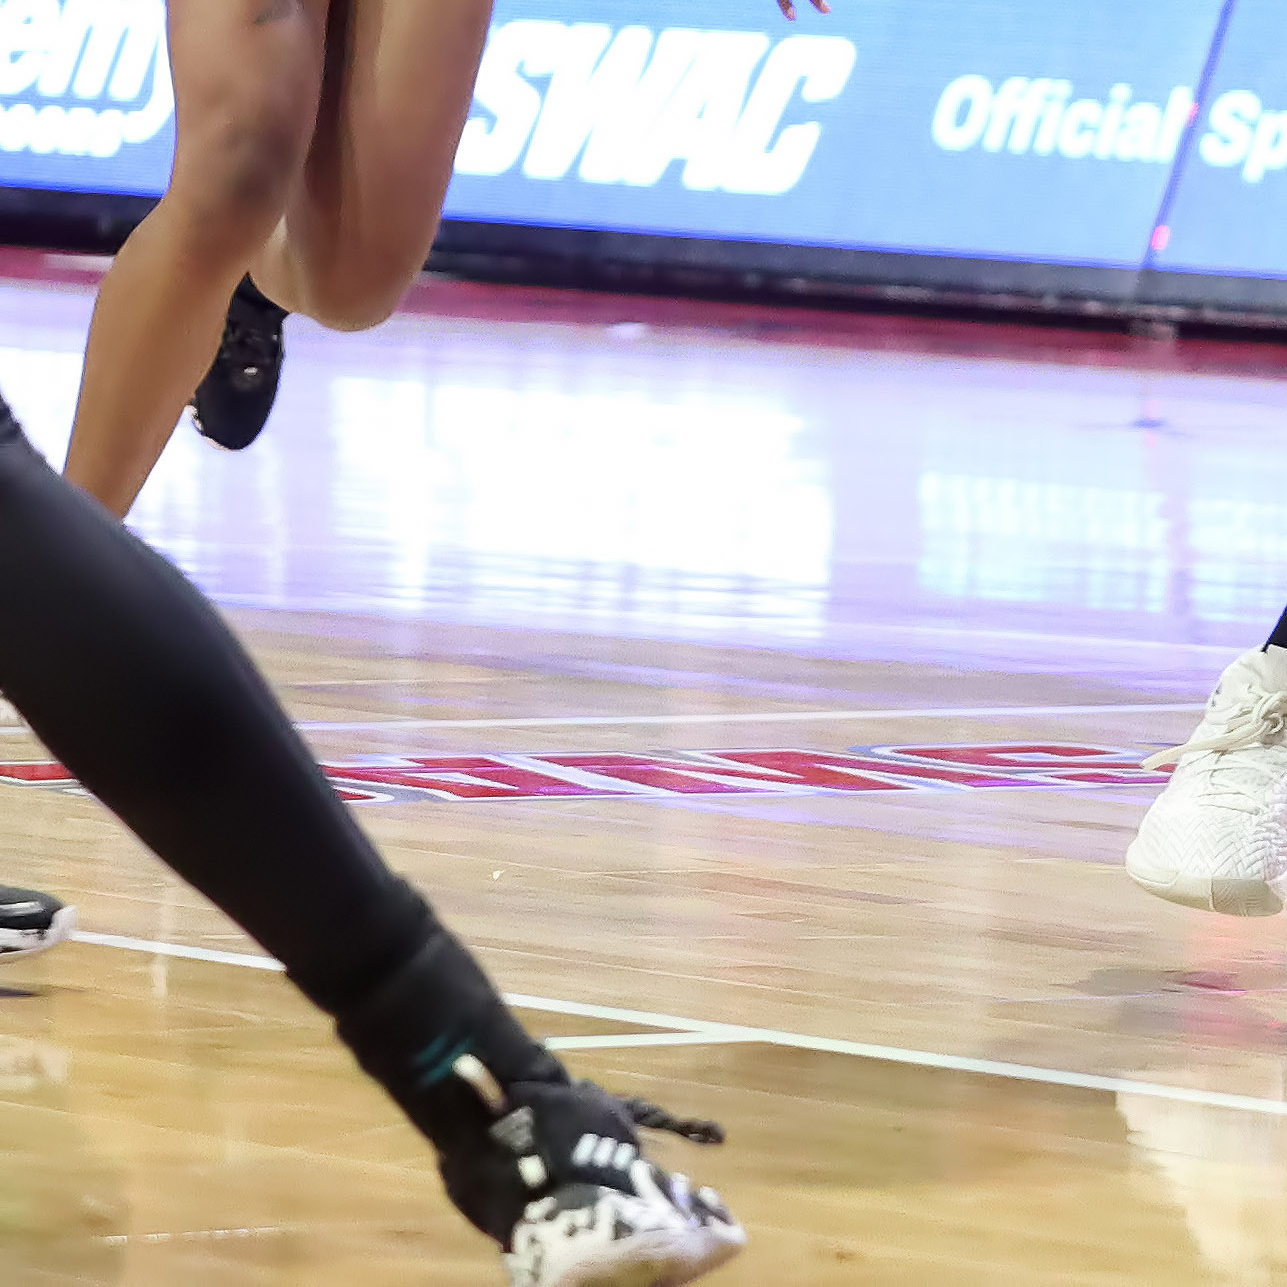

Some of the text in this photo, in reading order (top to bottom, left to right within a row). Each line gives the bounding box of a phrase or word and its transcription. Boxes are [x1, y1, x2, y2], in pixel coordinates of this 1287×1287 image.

[453, 18, 858, 196] SWAC
[931, 73, 1193, 165] Official
[322, 741, 1174, 804] SWA
